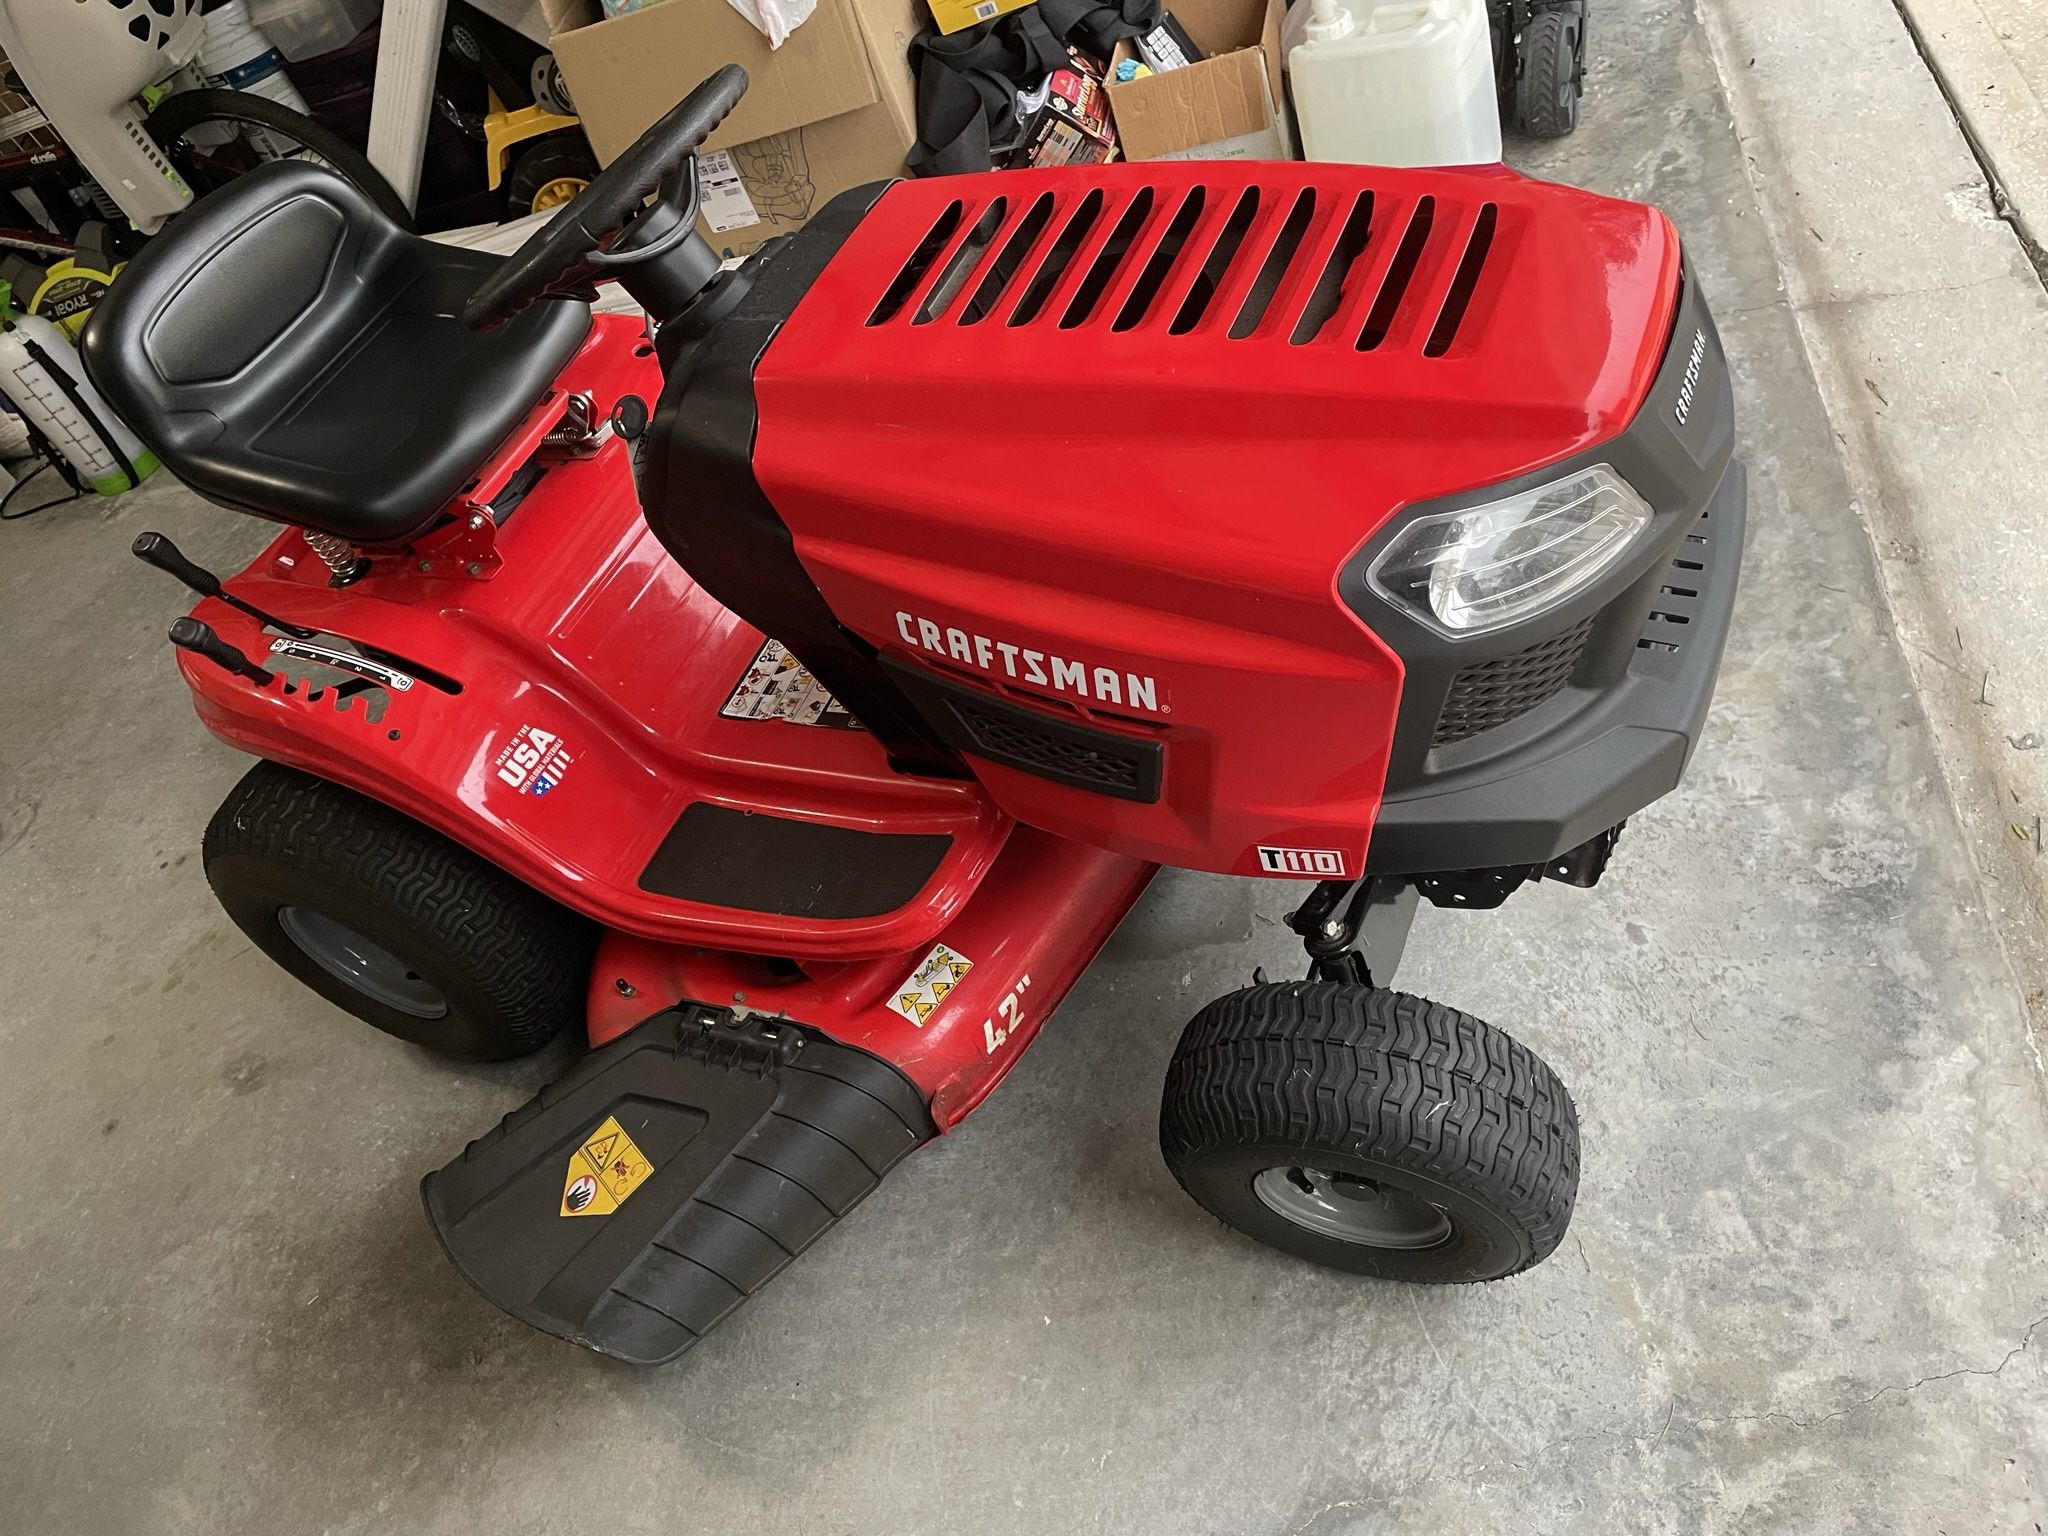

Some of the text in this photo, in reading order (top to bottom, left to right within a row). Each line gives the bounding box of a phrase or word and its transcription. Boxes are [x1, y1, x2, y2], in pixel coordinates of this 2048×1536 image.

[54, 294, 90, 316] RYOBI
[1675, 328, 1706, 424] CRAFTSMAN
[895, 611, 1158, 712] CRAFTSMAN
[495, 723, 532, 767] MADE IN THE
[497, 727, 557, 788] USA
[518, 738, 564, 795] WITH GLOBAL MATERIALS
[1260, 848, 1338, 873] T110
[983, 974, 1032, 1056] 42"
